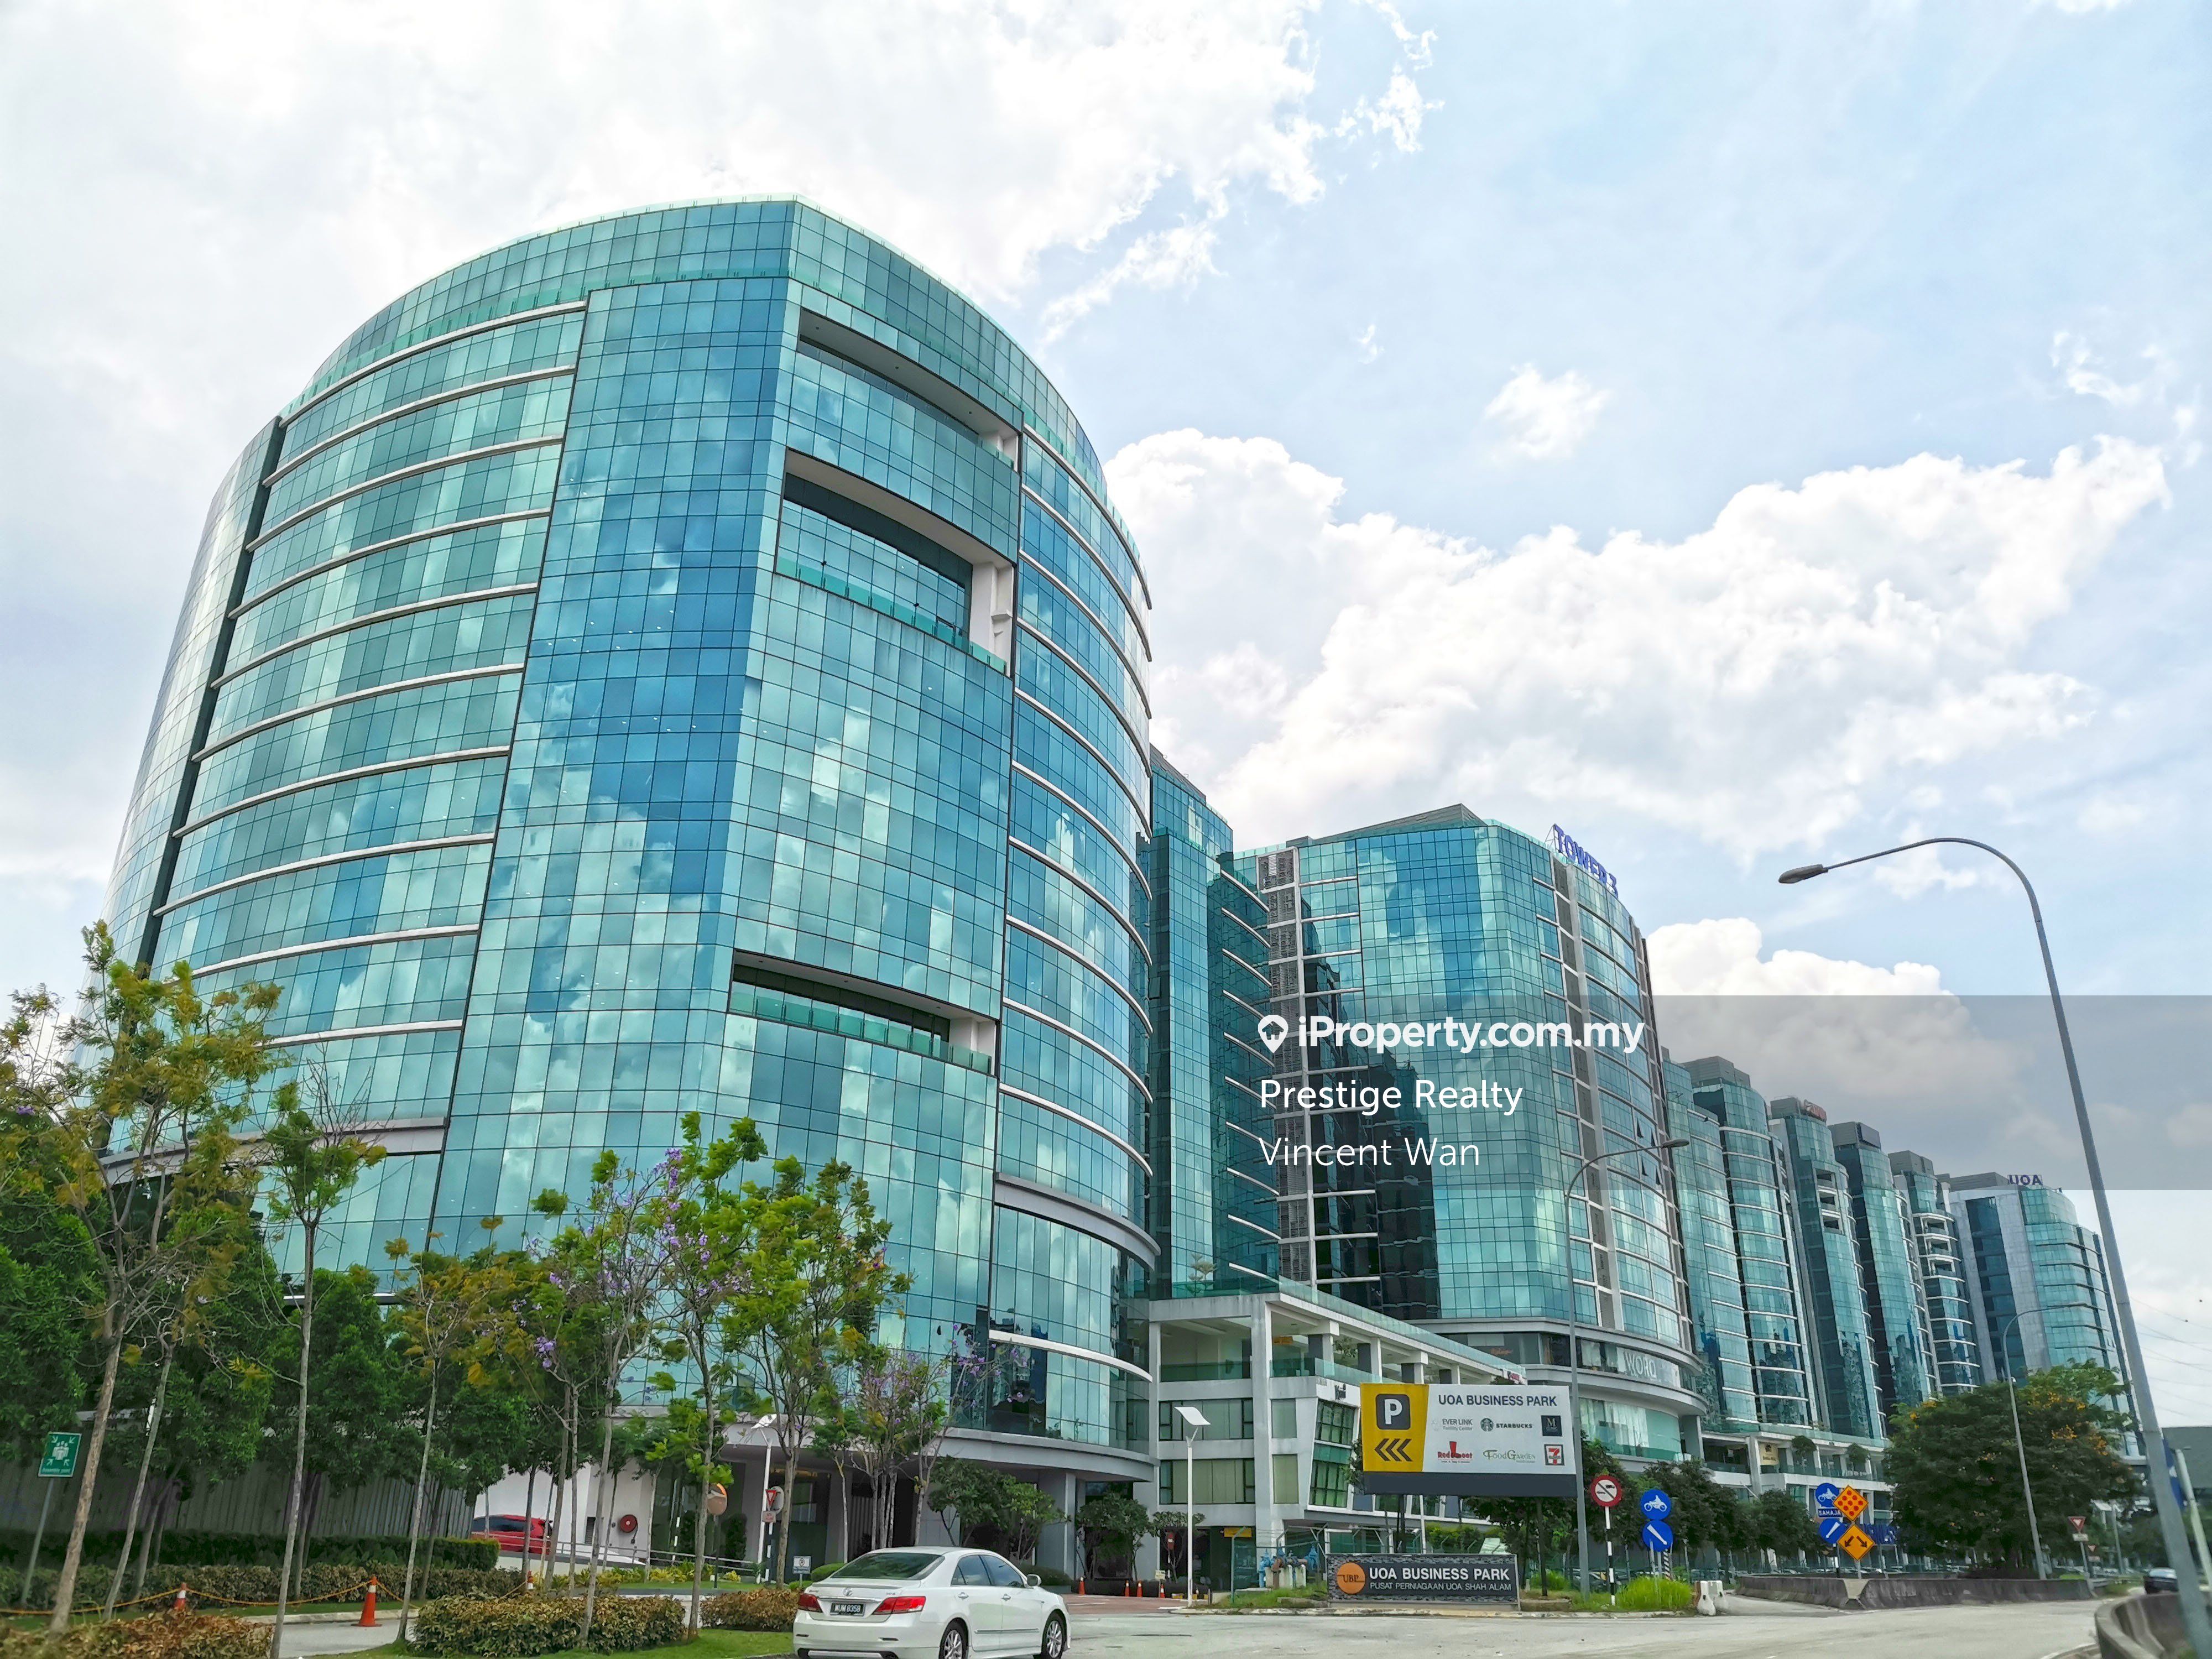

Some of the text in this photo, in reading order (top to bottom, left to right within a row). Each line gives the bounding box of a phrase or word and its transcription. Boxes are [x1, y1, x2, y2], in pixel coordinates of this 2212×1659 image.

[1553, 823, 1607, 884] TOWER
[2009, 1175, 2042, 1185] UOA
[1438, 1395, 1557, 1406] UOA BUSINESS PARK
[1384, 1399, 1402, 1425] P
[1369, 1567, 1510, 1580] UOA BUSINESS PARK
